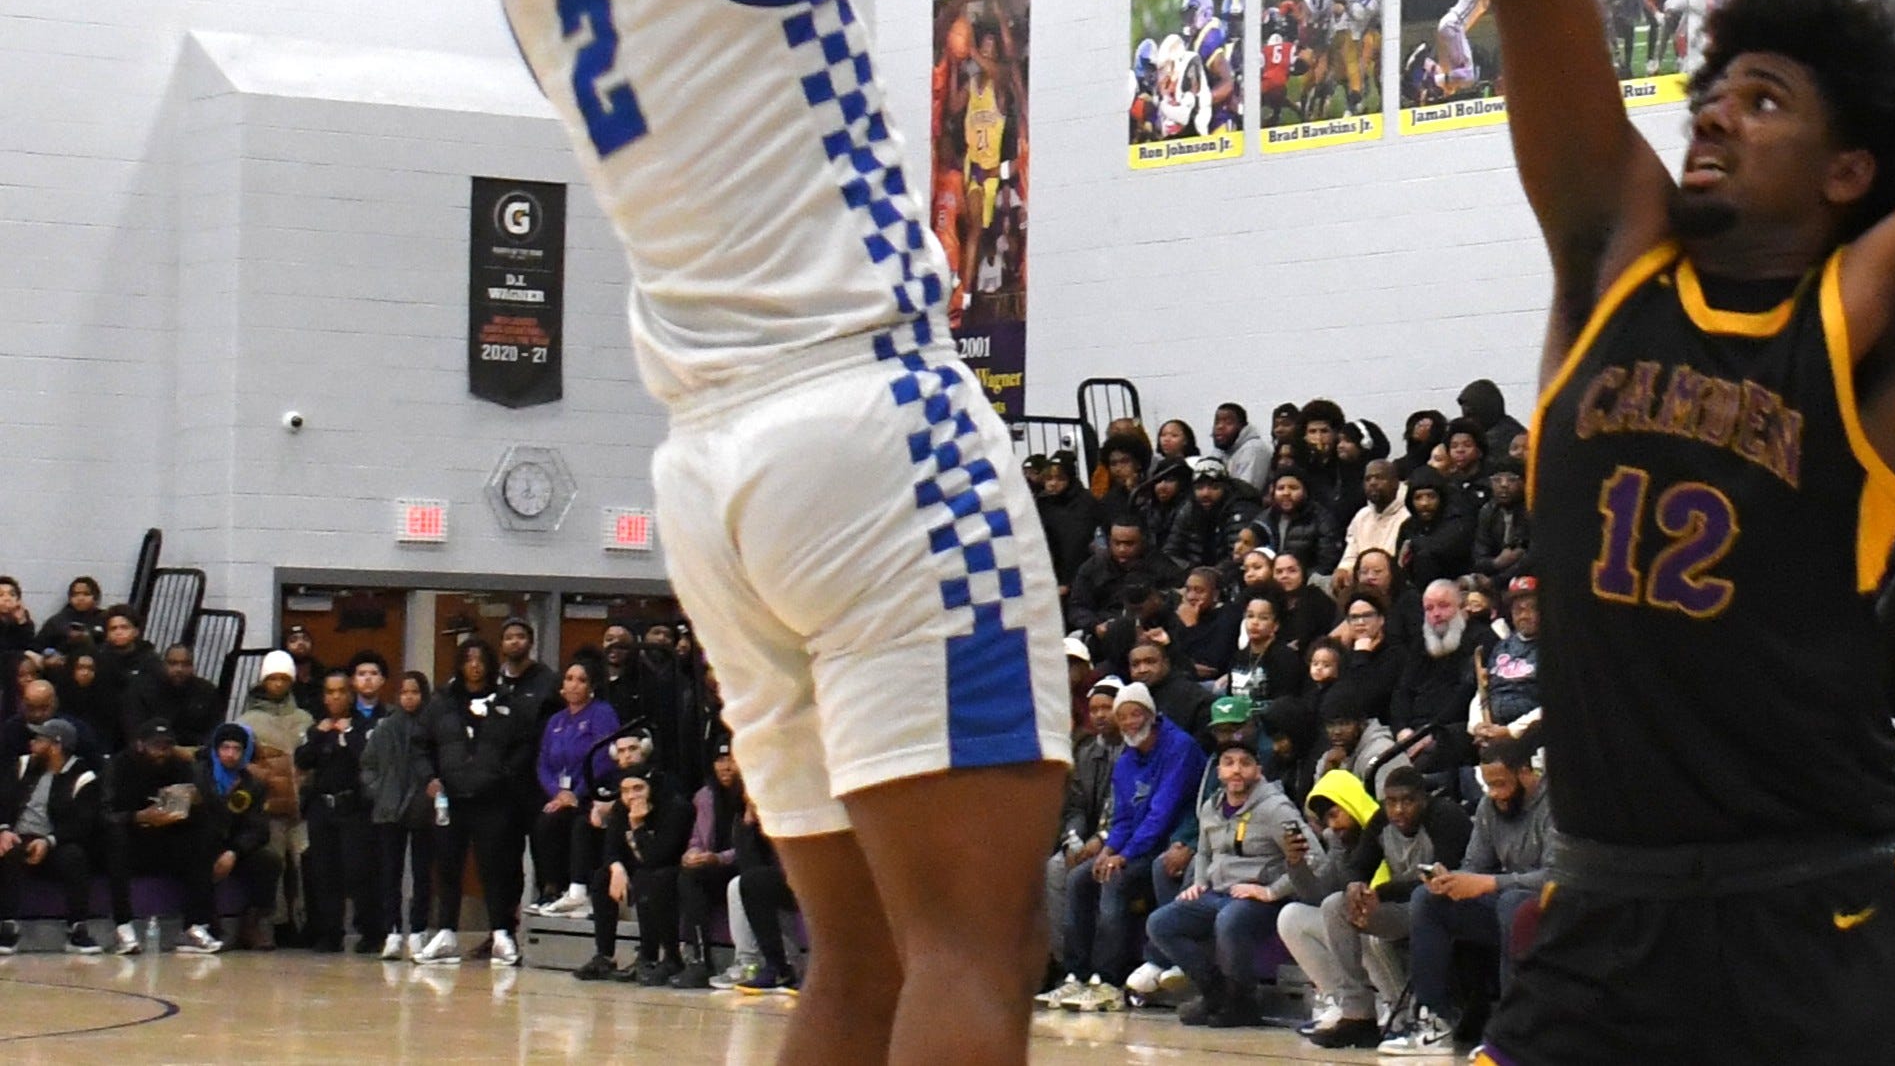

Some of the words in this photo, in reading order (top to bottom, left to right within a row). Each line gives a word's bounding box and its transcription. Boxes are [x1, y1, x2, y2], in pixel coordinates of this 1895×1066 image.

[1623, 85, 1657, 98] Ruiz
[1411, 105, 1452, 126] Jamal
[1456, 101, 1507, 118] Hollow
[1268, 126, 1299, 143] Brad
[1301, 122, 1356, 139] Hawkins
[1359, 118, 1374, 134] Jr.
[1139, 147, 1163, 160] Ron
[1165, 141, 1217, 160] Johnson
[1219, 137, 1233, 153] Jr.
[503, 201, 531, 234] G
[481, 343, 518, 362] 2020
[532, 346, 548, 363] 21
[958, 336, 991, 359] 2001
[1576, 361, 1803, 489] CAMDEN
[1591, 465, 1740, 618] 12
